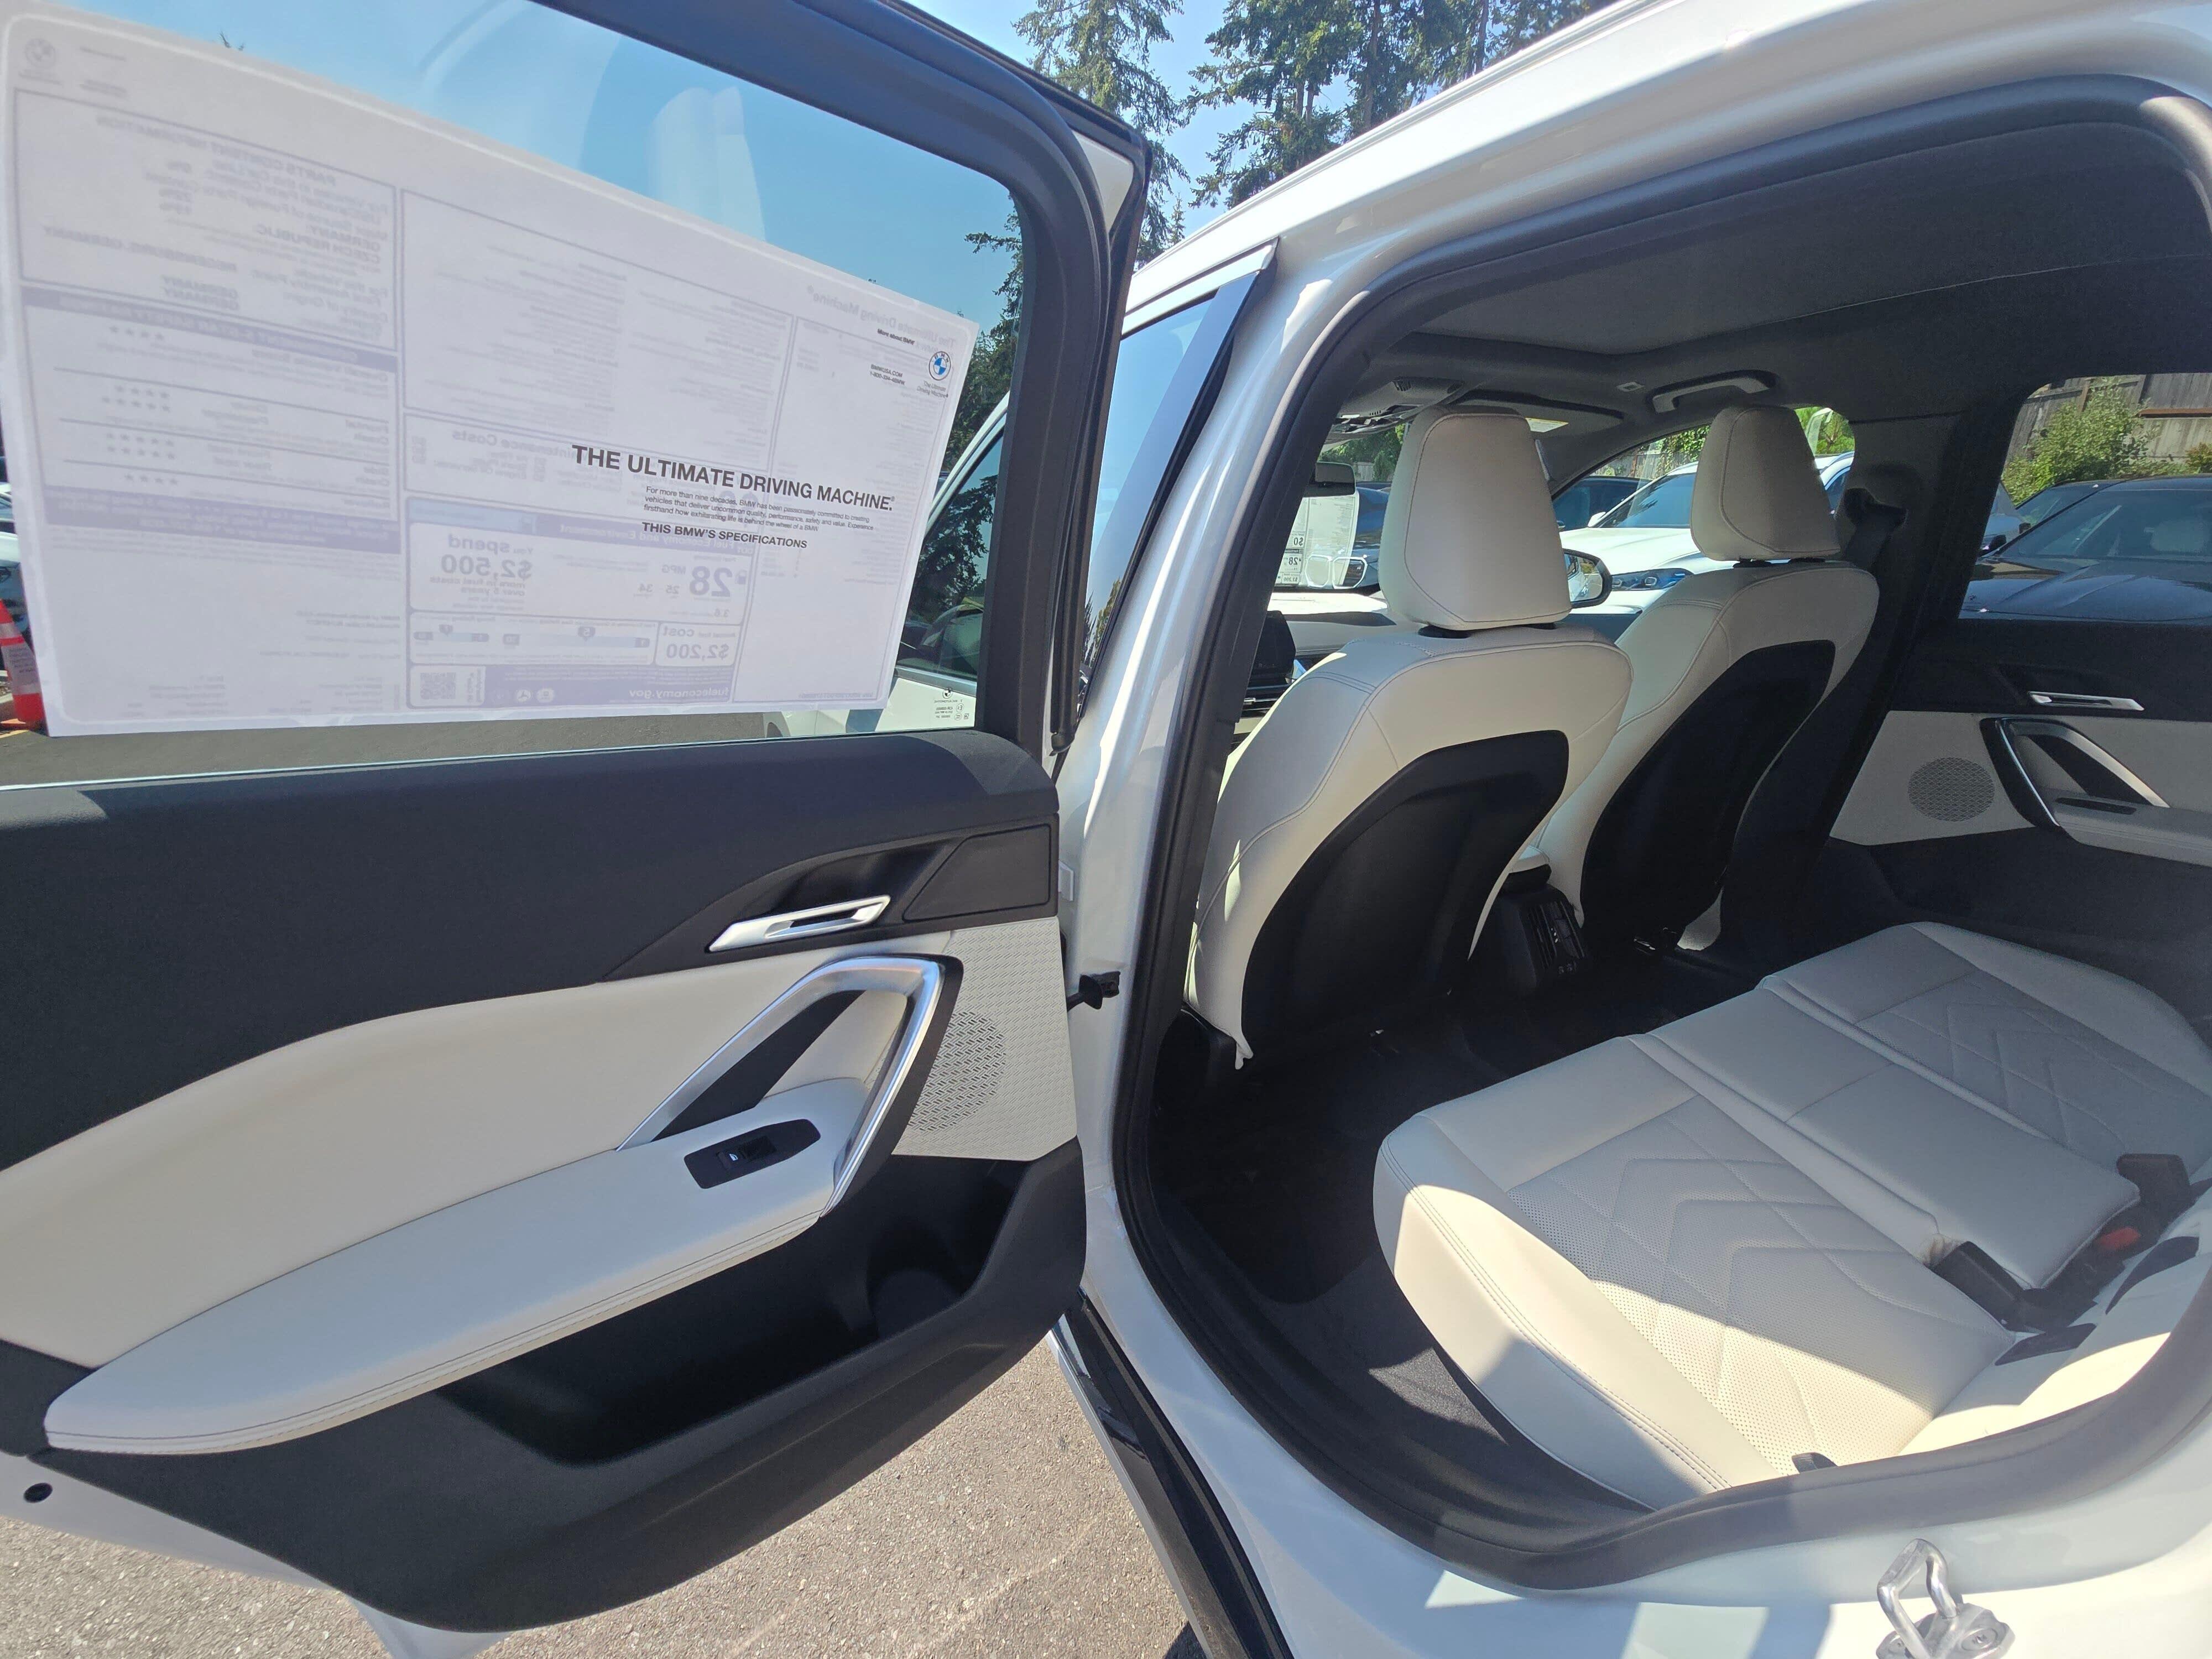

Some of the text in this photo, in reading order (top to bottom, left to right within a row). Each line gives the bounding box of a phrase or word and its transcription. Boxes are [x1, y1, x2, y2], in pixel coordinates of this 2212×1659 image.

[571, 444, 621, 470] THE
[627, 454, 735, 488] ULTIMATE
[739, 473, 812, 499] DRIVING
[644, 495, 673, 505] vehicles
[688, 502, 711, 510] deliver
[711, 505, 745, 515] uncommon
[746, 509, 767, 519] quality,
[847, 522, 874, 531] Experience
[644, 504, 674, 514] firsthand
[675, 507, 690, 516] how
[691, 511, 726, 522] exhilarating
[744, 517, 765, 526] behind
[646, 486, 658, 494] For
[659, 488, 677, 497] more
[679, 491, 693, 499] than
[739, 499, 756, 508] BMW
[783, 507, 816, 517] passionately
[817, 510, 844, 520] committed
[850, 515, 870, 524] creating
[641, 521, 807, 549] THIS BMW'S SPECIFICATIONS
